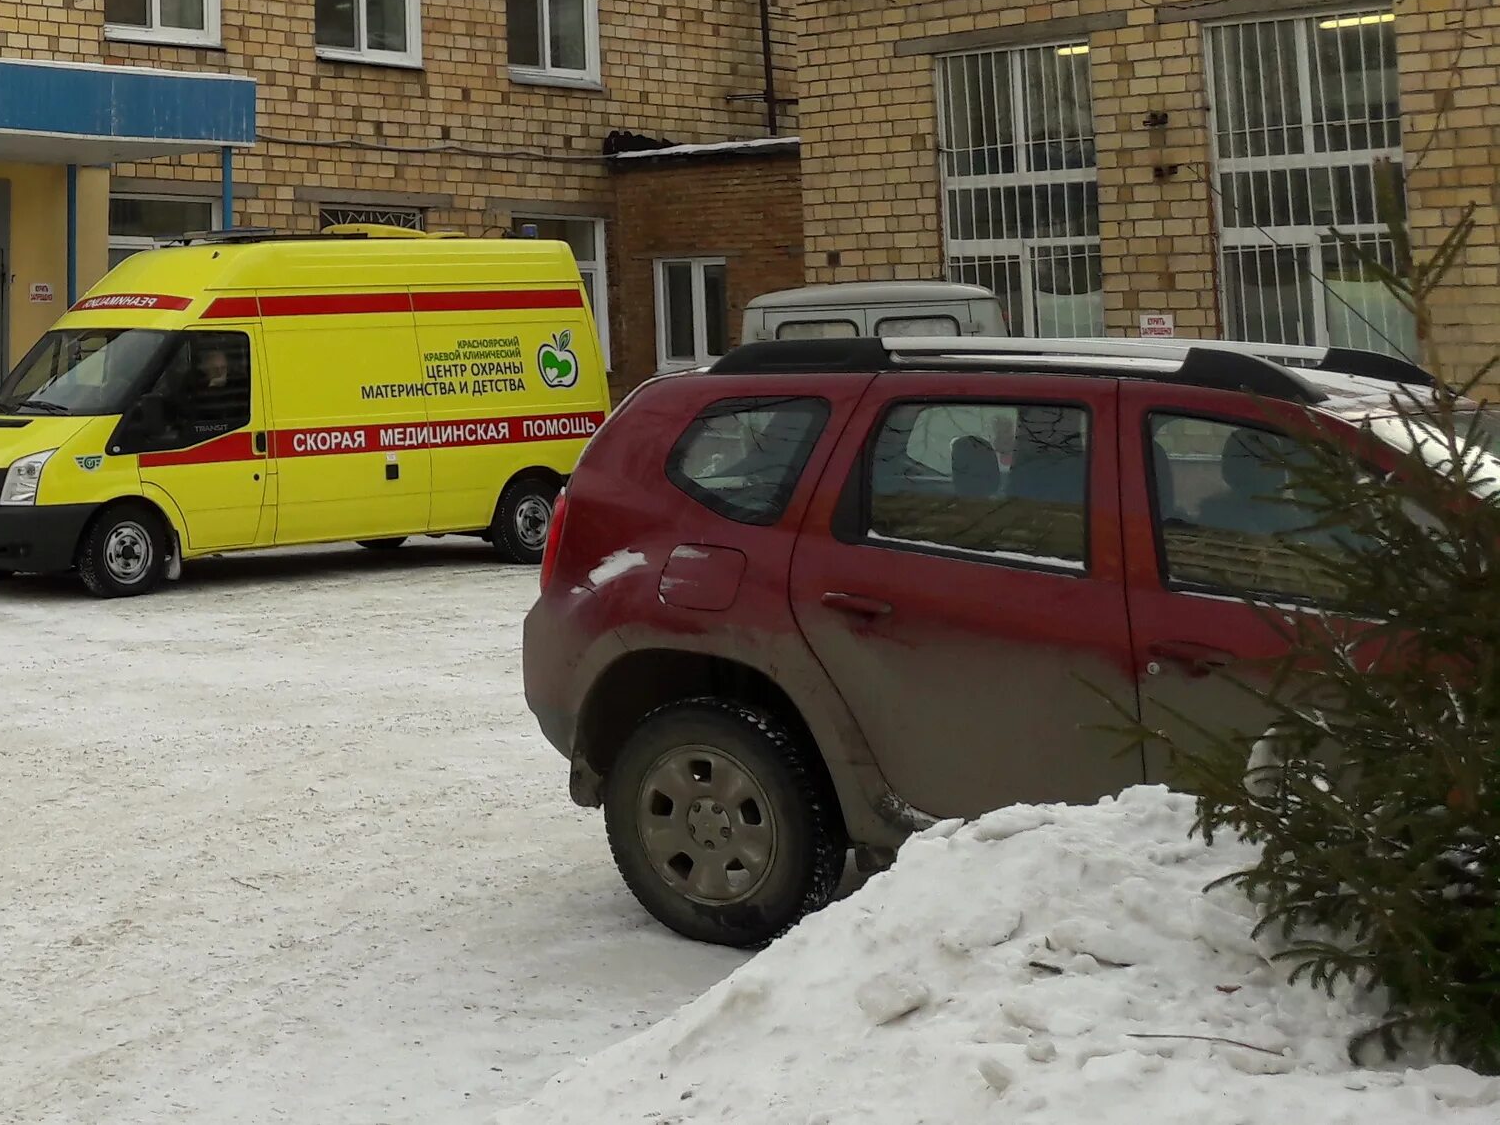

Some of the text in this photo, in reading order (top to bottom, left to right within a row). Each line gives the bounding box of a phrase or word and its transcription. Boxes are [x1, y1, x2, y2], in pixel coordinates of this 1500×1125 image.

[457, 336, 520, 350] КРАСНОЯРСКИЙ
[424, 348, 522, 362] КРАЕВОЙ КЛИНИЧЕСКИЙ
[426, 361, 524, 381] ЦЕНТР ОХРАНЫ
[361, 377, 526, 400] МАТЕРИНСТВА И ДЕТСТВА
[293, 416, 596, 452] СКОРАЯ МЕДИЦИНСКАЯ ПОМОЩЬ
